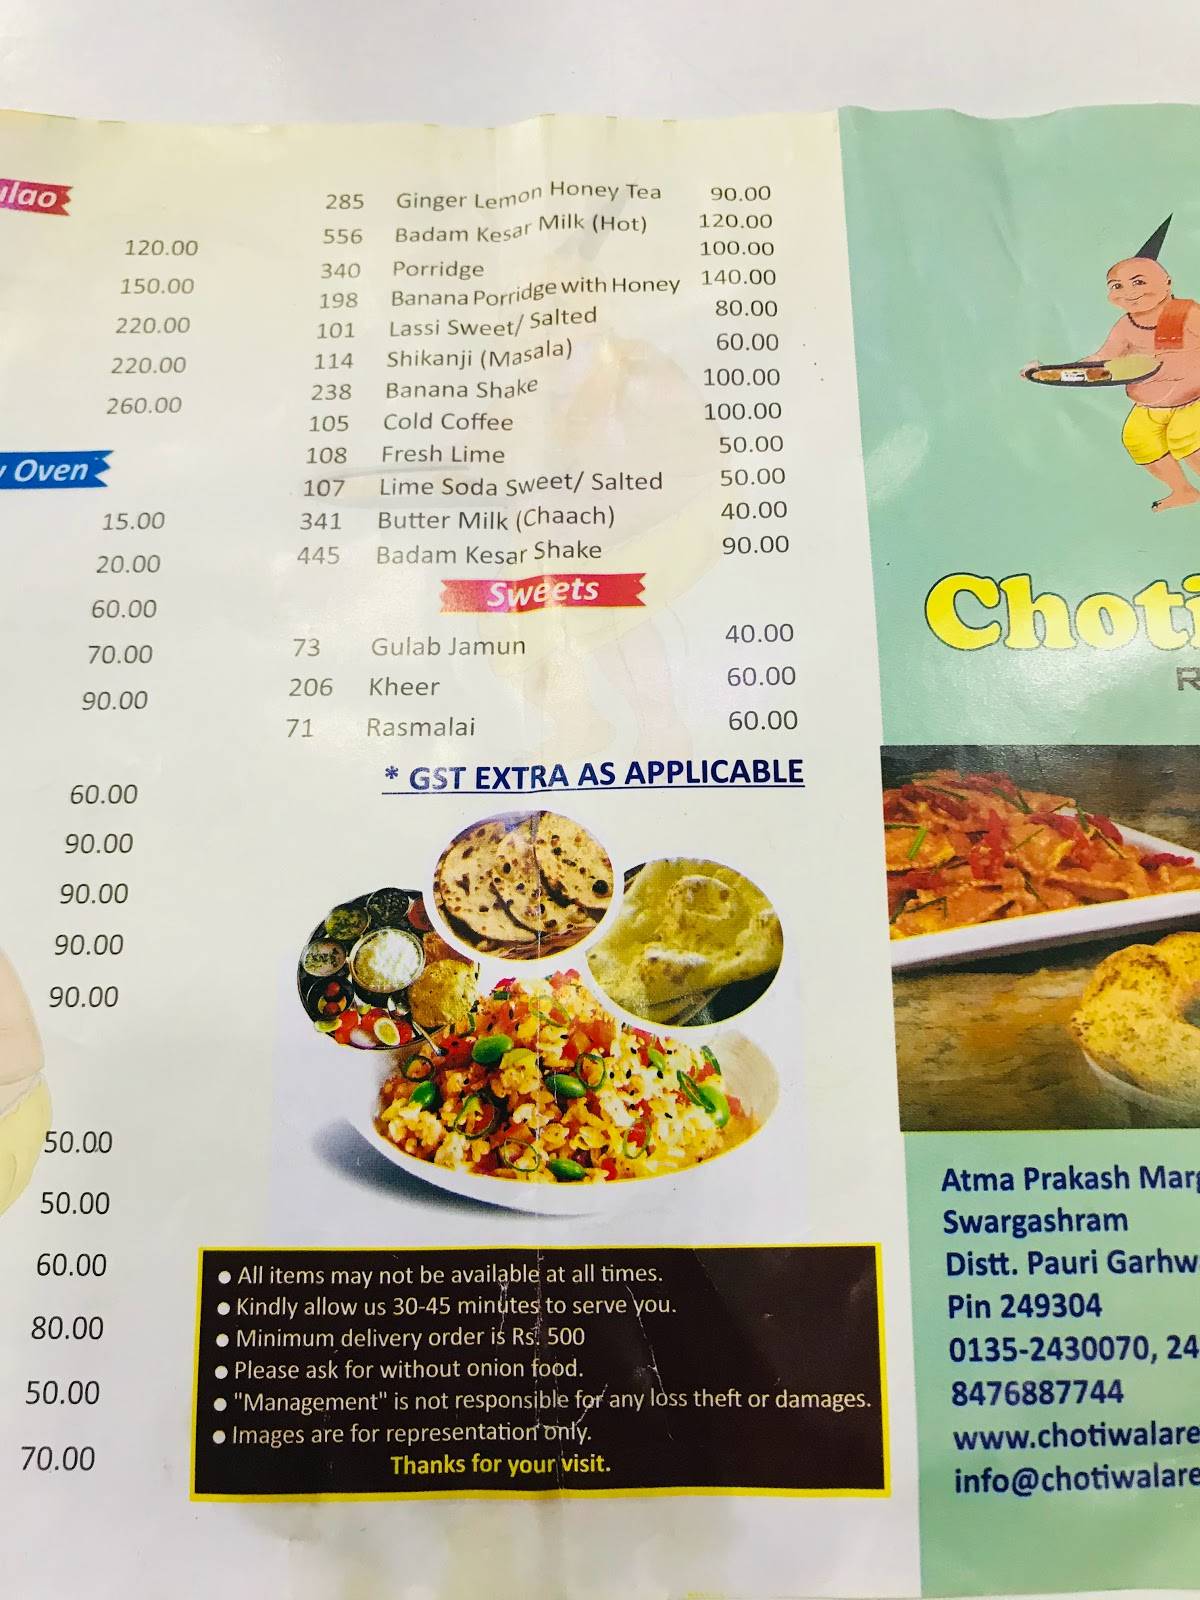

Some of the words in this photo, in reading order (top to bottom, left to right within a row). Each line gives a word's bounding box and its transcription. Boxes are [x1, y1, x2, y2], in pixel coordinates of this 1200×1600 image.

[325, 193, 365, 210] 285
[396, 192, 468, 212] Ginger
[474, 186, 542, 210] Lemon
[550, 180, 620, 202] Honey
[625, 183, 661, 200] Tea
[710, 185, 771, 202] 90.00
[323, 228, 363, 245] 556
[395, 226, 469, 243] Badam
[476, 222, 532, 243] Kesar
[539, 213, 585, 231] Milk
[592, 213, 647, 235] (Hot)
[699, 213, 773, 229] 120.00
[125, 239, 199, 257] 120.00
[320, 262, 361, 280] 340
[393, 260, 485, 281] Porridge
[700, 240, 775, 256] 100.00
[120, 277, 195, 295] 150.00
[319, 292, 359, 310] 198
[391, 290, 469, 307] Banana
[473, 282, 557, 307] Porridge
[560, 276, 607, 294] with
[612, 277, 681, 295] Honey
[702, 269, 777, 286] 140.00
[115, 316, 191, 334] 220.00
[316, 322, 355, 340] 101
[389, 319, 440, 338] Lassi
[447, 313, 525, 337] Sweet/
[530, 305, 597, 329] Salted
[715, 299, 778, 317] 80.00
[314, 352, 354, 370] 114
[386, 349, 472, 371] Shikanji
[480, 337, 572, 371] (Masala)
[716, 332, 779, 352] 60.00
[111, 356, 187, 375] 220.00
[311, 383, 352, 401] 238
[386, 382, 468, 399] Banana
[476, 378, 538, 399] Shake
[703, 368, 781, 387] 100.00
[106, 396, 183, 415] 260.00
[309, 415, 349, 433] 105
[383, 411, 433, 431] Cold
[440, 412, 514, 431] Coffee
[704, 402, 782, 421] 100.00
[306, 446, 347, 465] 108
[382, 443, 443, 463] Fresh
[451, 445, 505, 464] Lime
[719, 435, 784, 454] 50.00
[13, 457, 91, 483] Oven
[303, 479, 346, 497] 107
[380, 477, 434, 496] Lime
[441, 477, 498, 497] Soda
[505, 470, 585, 497] Sweet/
[591, 471, 663, 491] Salted
[720, 467, 786, 487] 50.00
[102, 511, 166, 531] 15.00
[299, 512, 342, 531] 341
[378, 511, 451, 530] Butter
[458, 511, 509, 531] Milk
[516, 505, 615, 534] (Chaach)
[720, 500, 788, 520] 40.00
[296, 545, 340, 565] 445
[376, 544, 457, 565] Badam
[466, 545, 528, 565] Kesar
[534, 539, 602, 560] Shake
[722, 535, 790, 555] 90.00
[95, 554, 161, 574] 20.00
[486, 576, 600, 609] Sweets
[91, 599, 157, 619] 60.00
[293, 638, 321, 657] 73
[371, 635, 441, 657] Gulab
[448, 636, 526, 656] Jamun
[725, 623, 794, 644] 40.00
[88, 644, 153, 665] 70.00
[288, 677, 333, 697] 206
[369, 676, 441, 697] Kheer
[727, 665, 796, 687] 60.00
[81, 690, 148, 711] 90.00
[286, 718, 314, 738] 71
[367, 716, 475, 737] Rasmalai
[728, 709, 798, 731] 60.00
[409, 766, 467, 791] GST
[475, 763, 570, 790] EXTRA
[577, 761, 616, 787] AS
[624, 759, 804, 785] APPLICABLE
[70, 783, 138, 805] 60.00
[64, 832, 134, 854] 90.00
[59, 882, 129, 905] 90.00
[54, 934, 124, 956] 90.00
[49, 985, 119, 1008] 90.00
[44, 1130, 113, 1154] 50.00
[941, 1167, 1015, 1192] Atma
[1023, 1164, 1130, 1191] Prakash
[40, 1191, 110, 1215] 50.00
[943, 1206, 1129, 1239] Swargashram
[36, 1252, 107, 1277] 60.00
[946, 1250, 1018, 1277] Distt.
[1027, 1248, 1098, 1276] Pauri
[237, 1265, 263, 1285] All
[270, 1265, 325, 1285] items
[331, 1270, 373, 1289] may
[379, 1267, 414, 1285] not
[420, 1264, 445, 1284] be
[451, 1263, 541, 1284] available
[546, 1266, 566, 1283] at
[571, 1263, 595, 1283] all
[600, 1263, 663, 1282] times.
[237, 1296, 299, 1320] Kindly
[304, 1296, 358, 1316] allow
[364, 1301, 387, 1316] us
[392, 1296, 451, 1316] 30-45
[458, 1295, 542, 1315] minutes
[545, 1297, 567, 1314] to
[572, 1299, 627, 1315] serve
[631, 1301, 677, 1317] you.
[948, 1293, 991, 1320] Pin
[1000, 1292, 1103, 1319] 249304
[31, 1315, 104, 1340] 80.00
[236, 1328, 334, 1348] Minimum
[340, 1327, 423, 1351] delivery
[428, 1326, 485, 1346] order
[547, 1327, 585, 1346] 500
[949, 1335, 1158, 1365] 0135-2430070,
[235, 1359, 300, 1380] Please
[305, 1359, 339, 1380] ask
[344, 1359, 374, 1379] for
[379, 1359, 461, 1379] without
[466, 1358, 524, 1377] onion
[25, 1380, 100, 1405] 50.00
[234, 1391, 387, 1416] "Management"
[394, 1391, 409, 1411] is
[415, 1392, 449, 1410] not
[455, 1389, 569, 1413] responsible
[609, 1393, 645, 1412] any
[650, 1387, 688, 1407] loss
[692, 1388, 743, 1408] theft
[747, 1393, 770, 1408] or
[775, 1388, 872, 1413] damages.
[951, 1378, 1125, 1407] 8476887744
[232, 1425, 305, 1449] Images
[311, 1428, 344, 1444] are
[349, 1422, 381, 1443] for
[386, 1422, 541, 1447] representation
[21, 1446, 96, 1472] 70.00
[390, 1453, 466, 1475] Thanks
[471, 1452, 503, 1473] for
[507, 1458, 556, 1478] your
[560, 1454, 611, 1473] visit.
